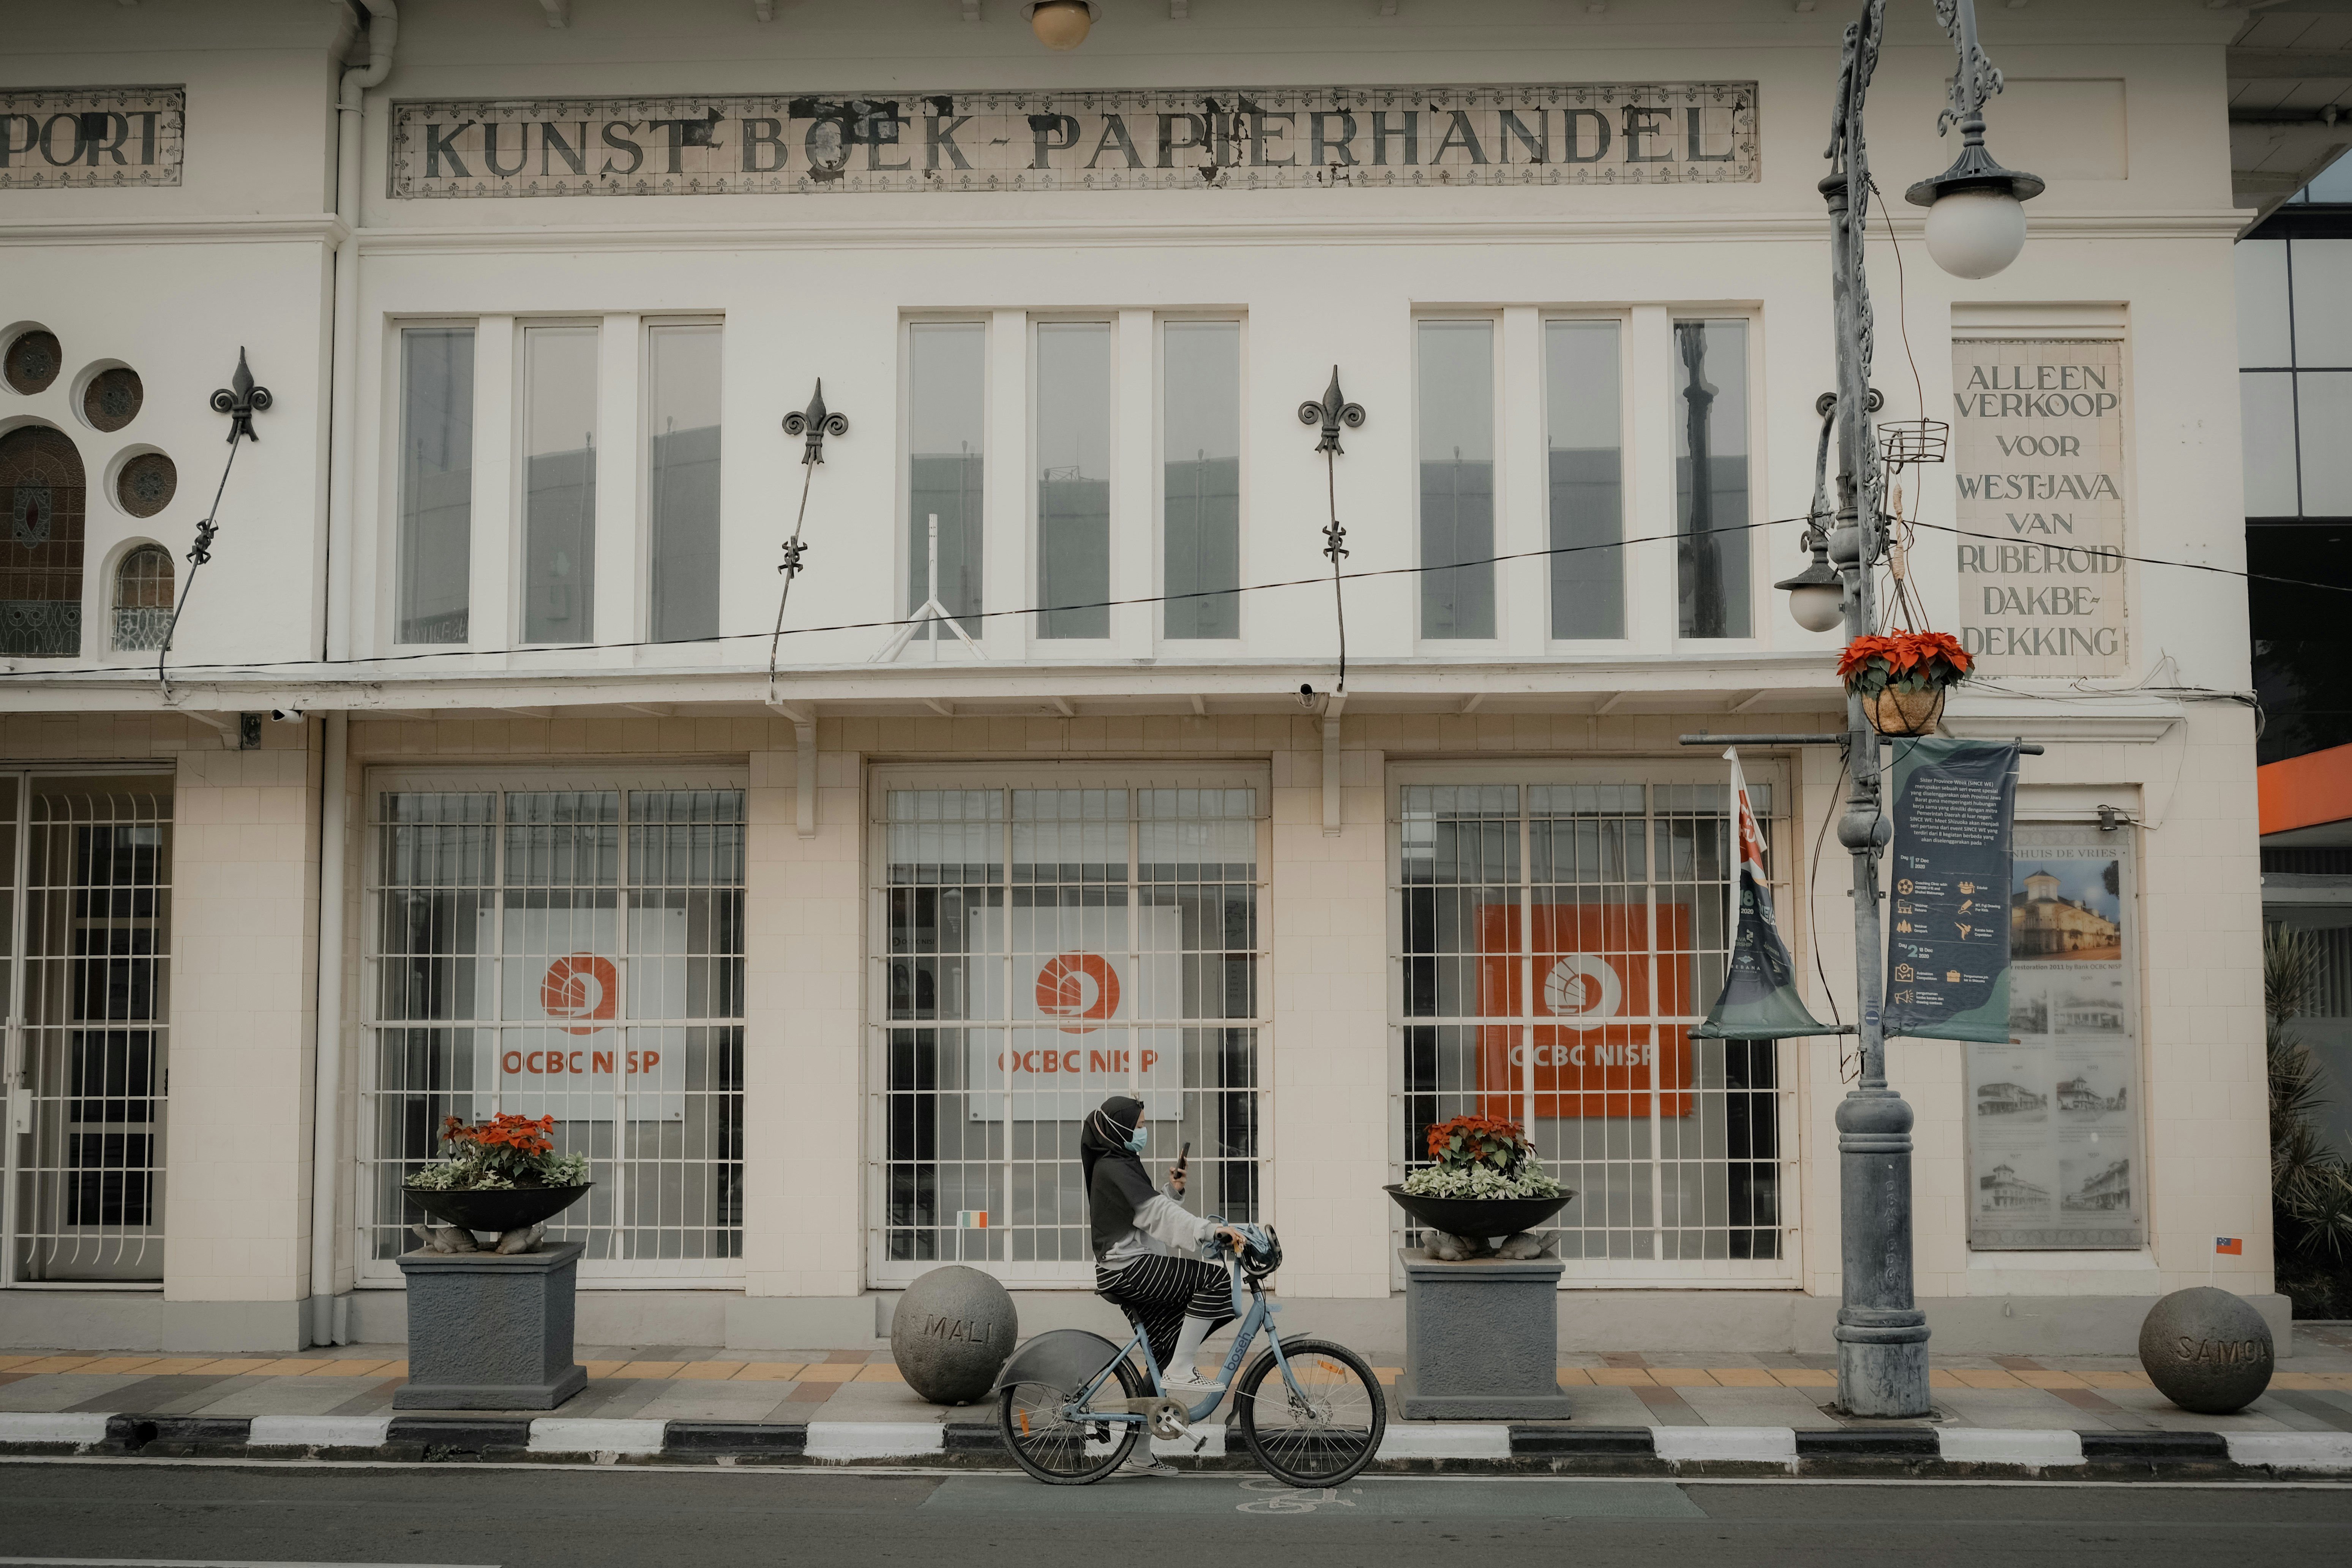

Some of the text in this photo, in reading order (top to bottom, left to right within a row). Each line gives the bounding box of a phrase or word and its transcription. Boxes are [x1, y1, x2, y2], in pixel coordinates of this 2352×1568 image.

[423, 120, 683, 177] KUNST
[742, 115, 974, 172] BOEK
[1030, 107, 1734, 169] PAPIERHANDEL
[1967, 366, 2106, 390] ALLEEN
[1954, 393, 2117, 417] VERKOOP
[1995, 436, 2079, 456] VOOR
[1956, 475, 2120, 499] WEST-JAVA
[2005, 513, 2073, 534] VAN
[1958, 545, 2122, 573] RUBEROID
[1962, 627, 2118, 656] DEKKING
[1910, 856, 1914, 868] 1
[1908, 944, 1918, 957] 2
[502, 1051, 659, 1074] OCBC NSP
[998, 1050, 1080, 1073] OCBC
[1510, 1045, 1586, 1066] OCBC
[924, 1314, 992, 1344] MALI
[1224, 1331, 1252, 1371] boseh
[2177, 1336, 2270, 1364] SAMOA
